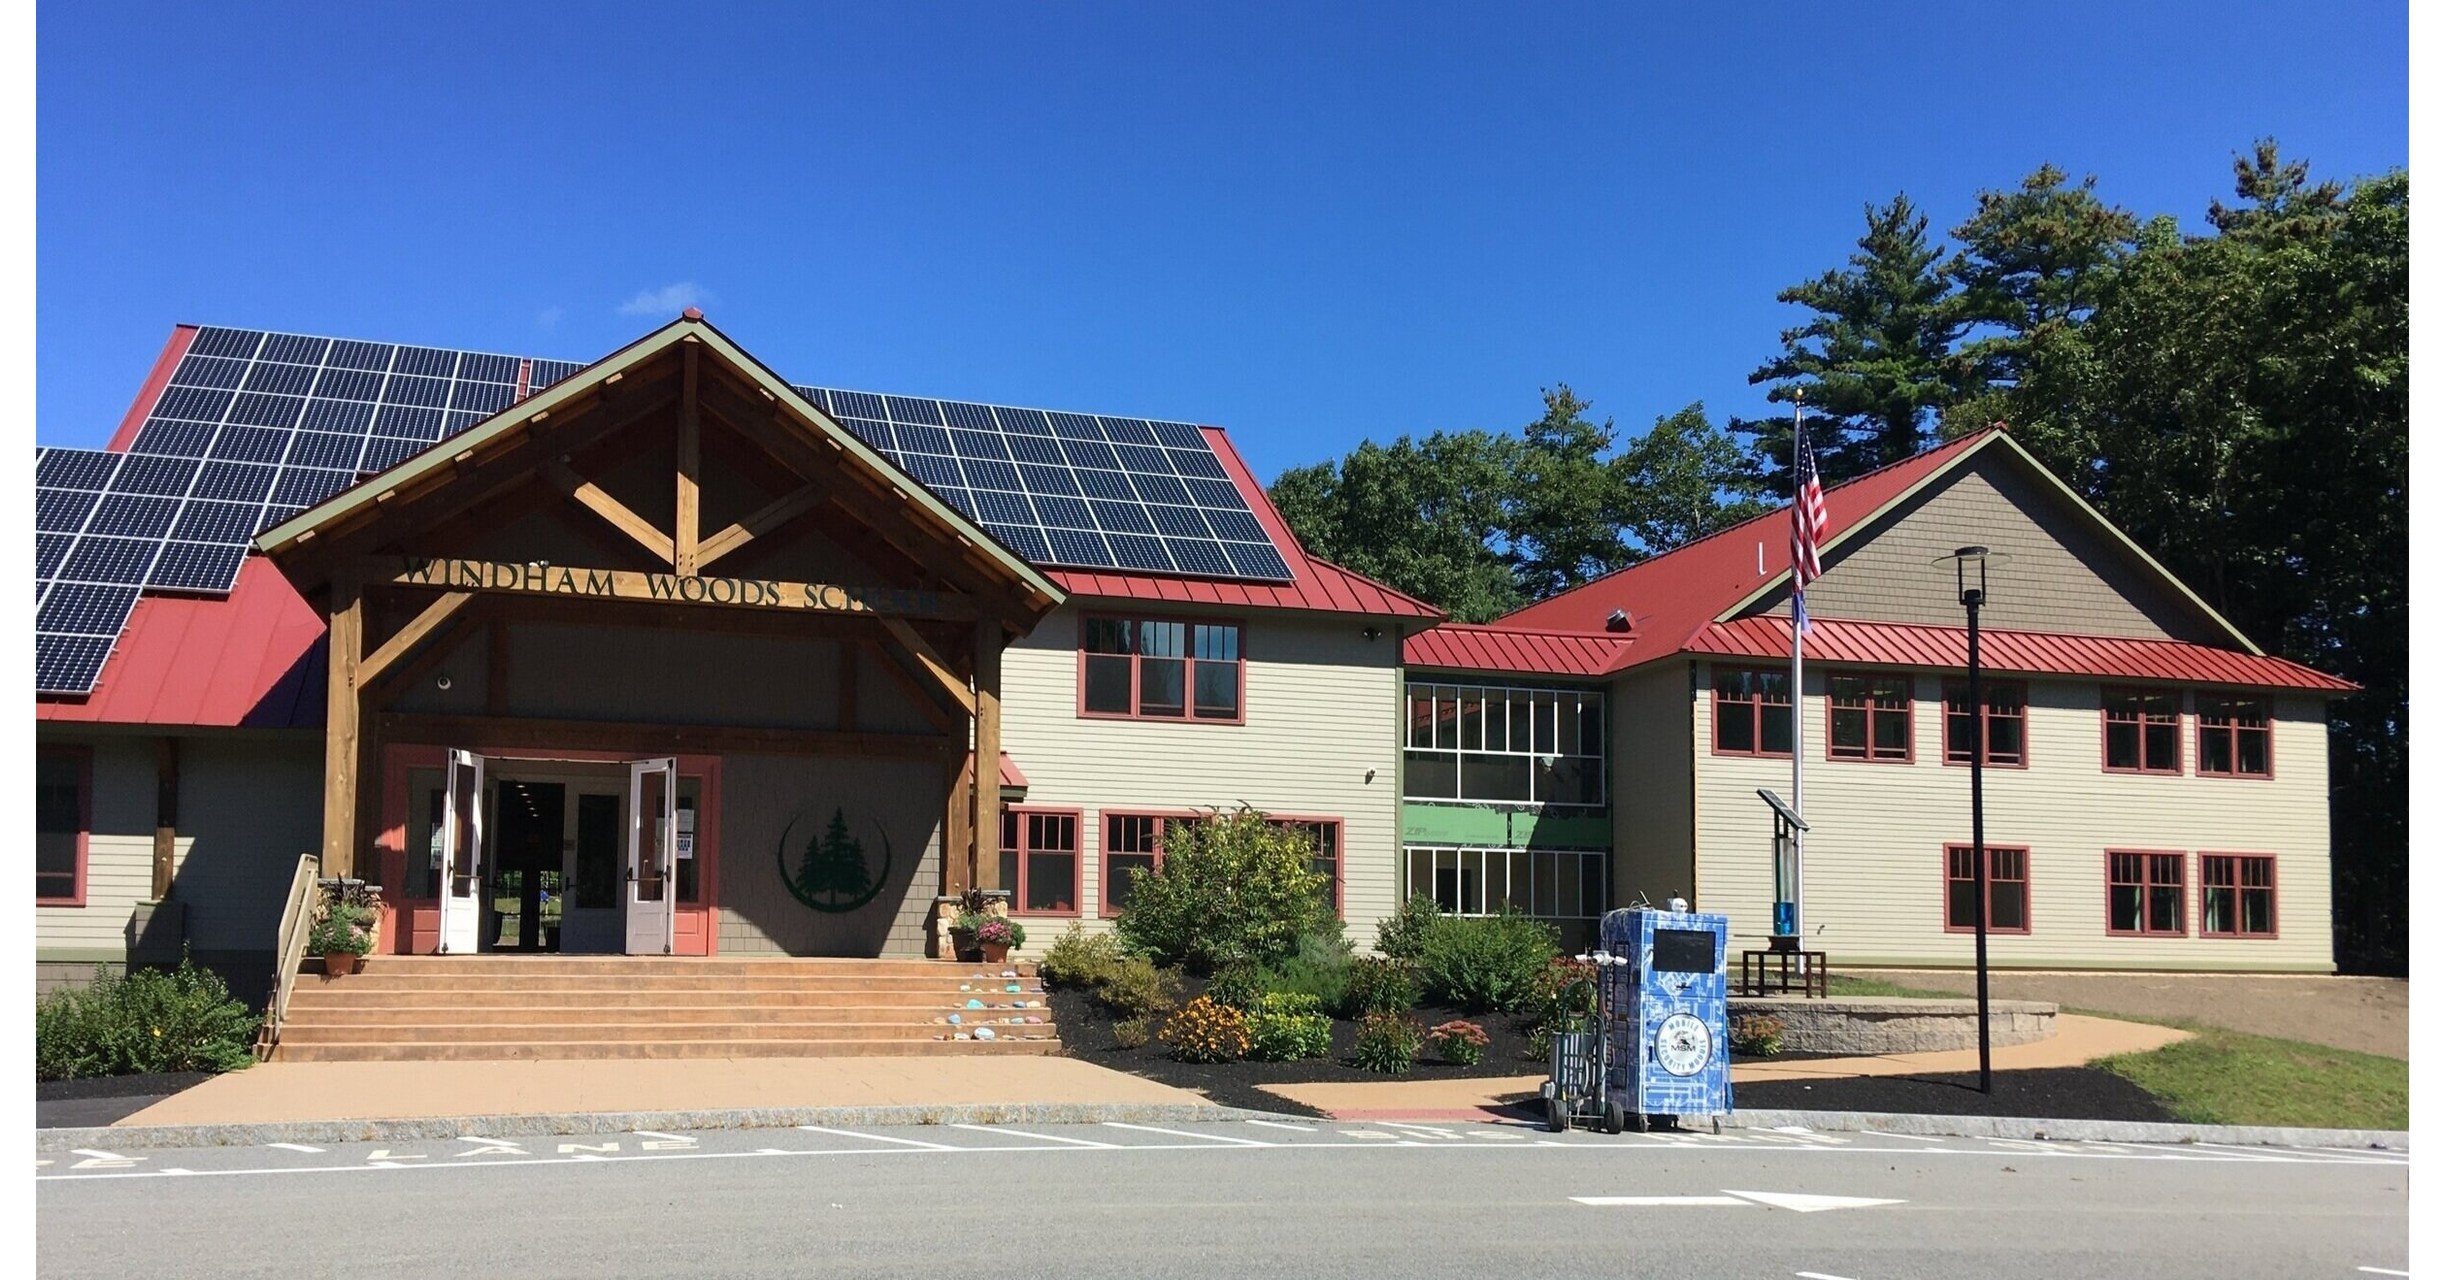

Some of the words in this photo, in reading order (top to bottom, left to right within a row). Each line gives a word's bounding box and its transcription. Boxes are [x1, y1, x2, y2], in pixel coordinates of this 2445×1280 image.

[402, 557, 616, 598] WINDHAM
[644, 570, 780, 607] WOODS
[1336, 1130, 1525, 1140] BUS
[366, 1140, 700, 1161] LANE
